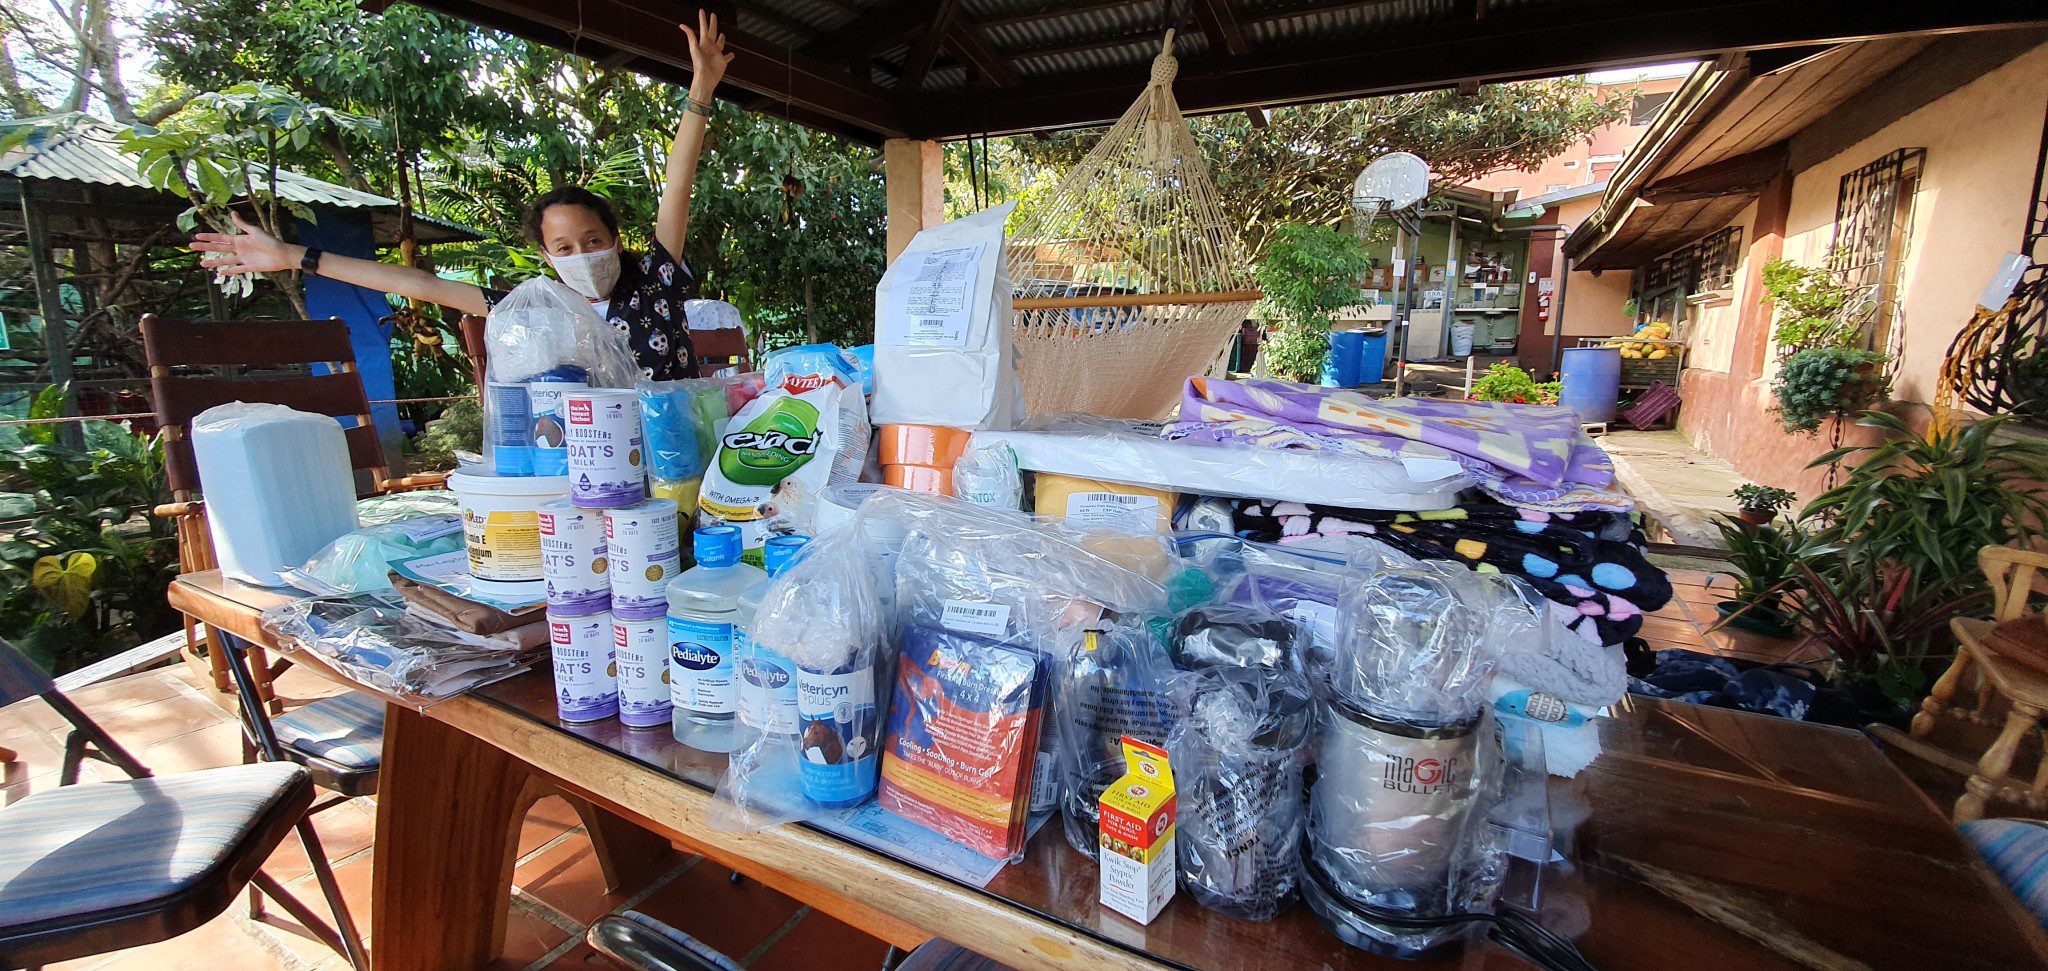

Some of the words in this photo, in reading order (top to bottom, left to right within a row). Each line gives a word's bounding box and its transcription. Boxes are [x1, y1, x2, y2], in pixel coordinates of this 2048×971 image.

[532, 388, 562, 398] etericy
[724, 430, 822, 454] exact
[709, 490, 724, 501] WITH
[545, 555, 574, 567] AT'S
[672, 646, 718, 665] Pedialyte
[554, 661, 591, 674] OAT'S
[618, 664, 645, 678] AT'S
[743, 662, 787, 683] Pedlyte
[800, 679, 848, 698] Vetericyn
[963, 680, 978, 691] Burn
[808, 695, 831, 706] plus
[960, 690, 966, 699] 4
[974, 694, 980, 704] 4
[899, 737, 922, 752] Cooling
[926, 748, 954, 766] Soothing
[960, 761, 977, 773] Burn
[1104, 811, 1124, 824] FIRST
[1126, 820, 1142, 831] AID
[1106, 824, 1117, 832] CATS
[1123, 831, 1138, 841] BIRDS
[1104, 852, 1121, 866] Kwik
[1110, 864, 1133, 880] Styptic
[1109, 873, 1134, 890] Powder
